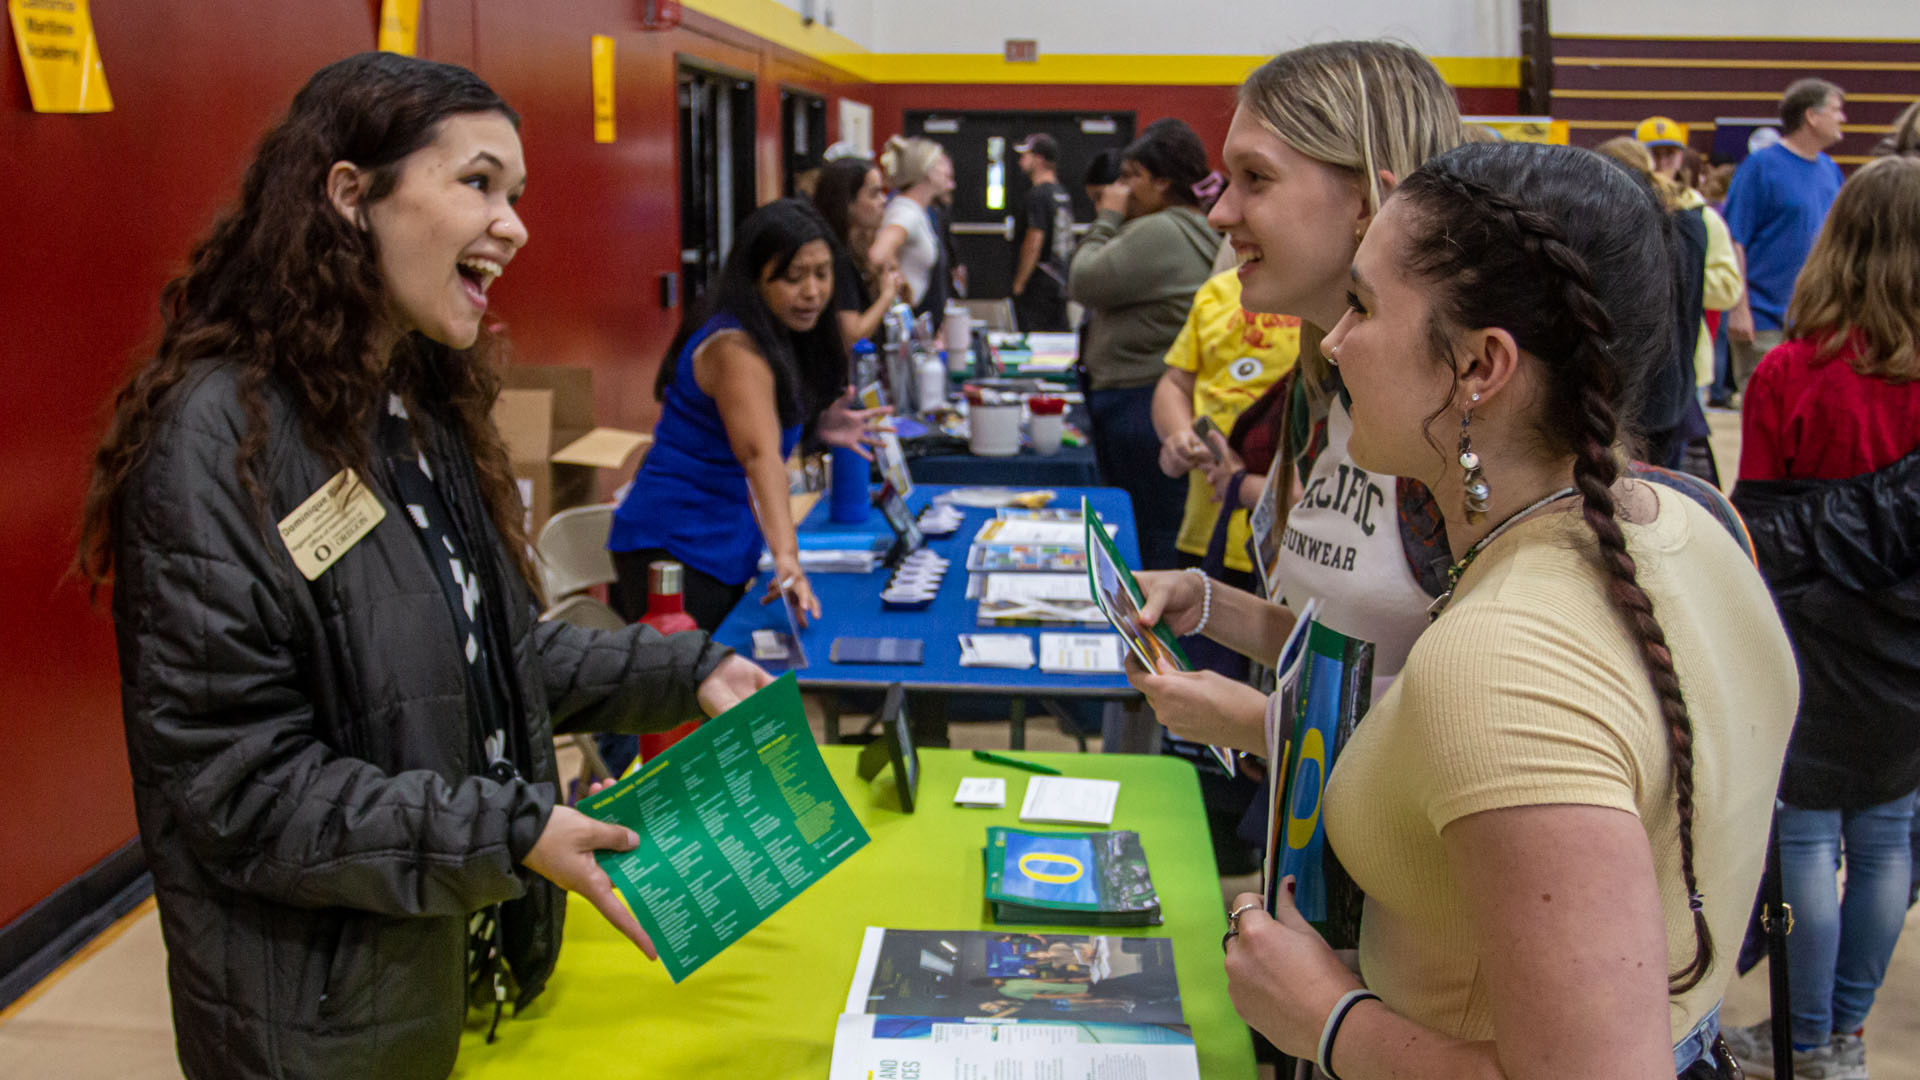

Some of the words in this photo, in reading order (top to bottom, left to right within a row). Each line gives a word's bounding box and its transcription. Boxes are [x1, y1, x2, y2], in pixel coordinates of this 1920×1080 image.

[281, 496, 328, 537] Dominique
[1299, 464, 1384, 537] ACIFIC
[879, 1059, 898, 1080] AND
